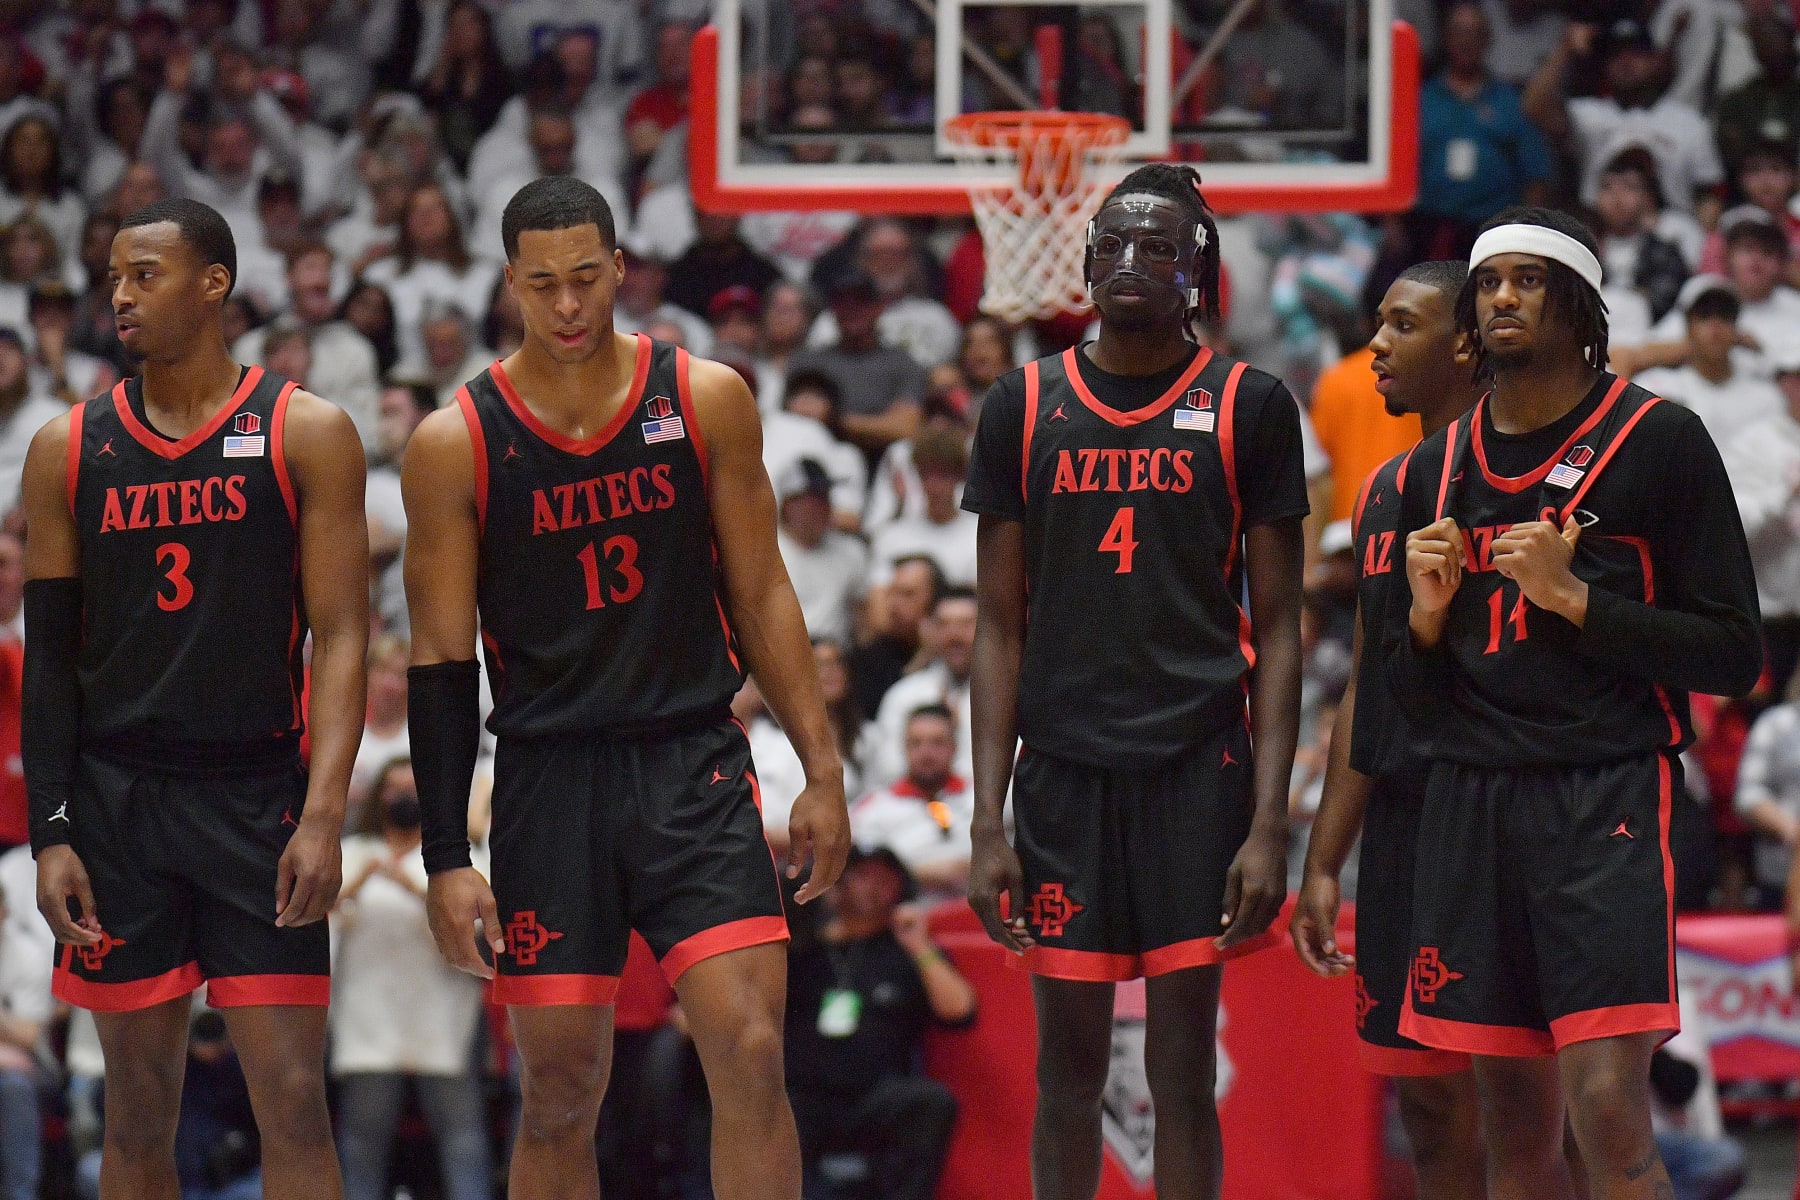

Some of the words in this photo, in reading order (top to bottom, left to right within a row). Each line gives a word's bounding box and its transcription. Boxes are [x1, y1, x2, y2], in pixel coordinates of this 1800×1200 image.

[99, 474, 247, 534] AZTECS
[532, 463, 676, 536] AZTECS
[1051, 447, 1194, 494] AZTECS
[576, 534, 644, 611] 13
[1098, 506, 1140, 574] 4
[155, 542, 194, 612] 3
